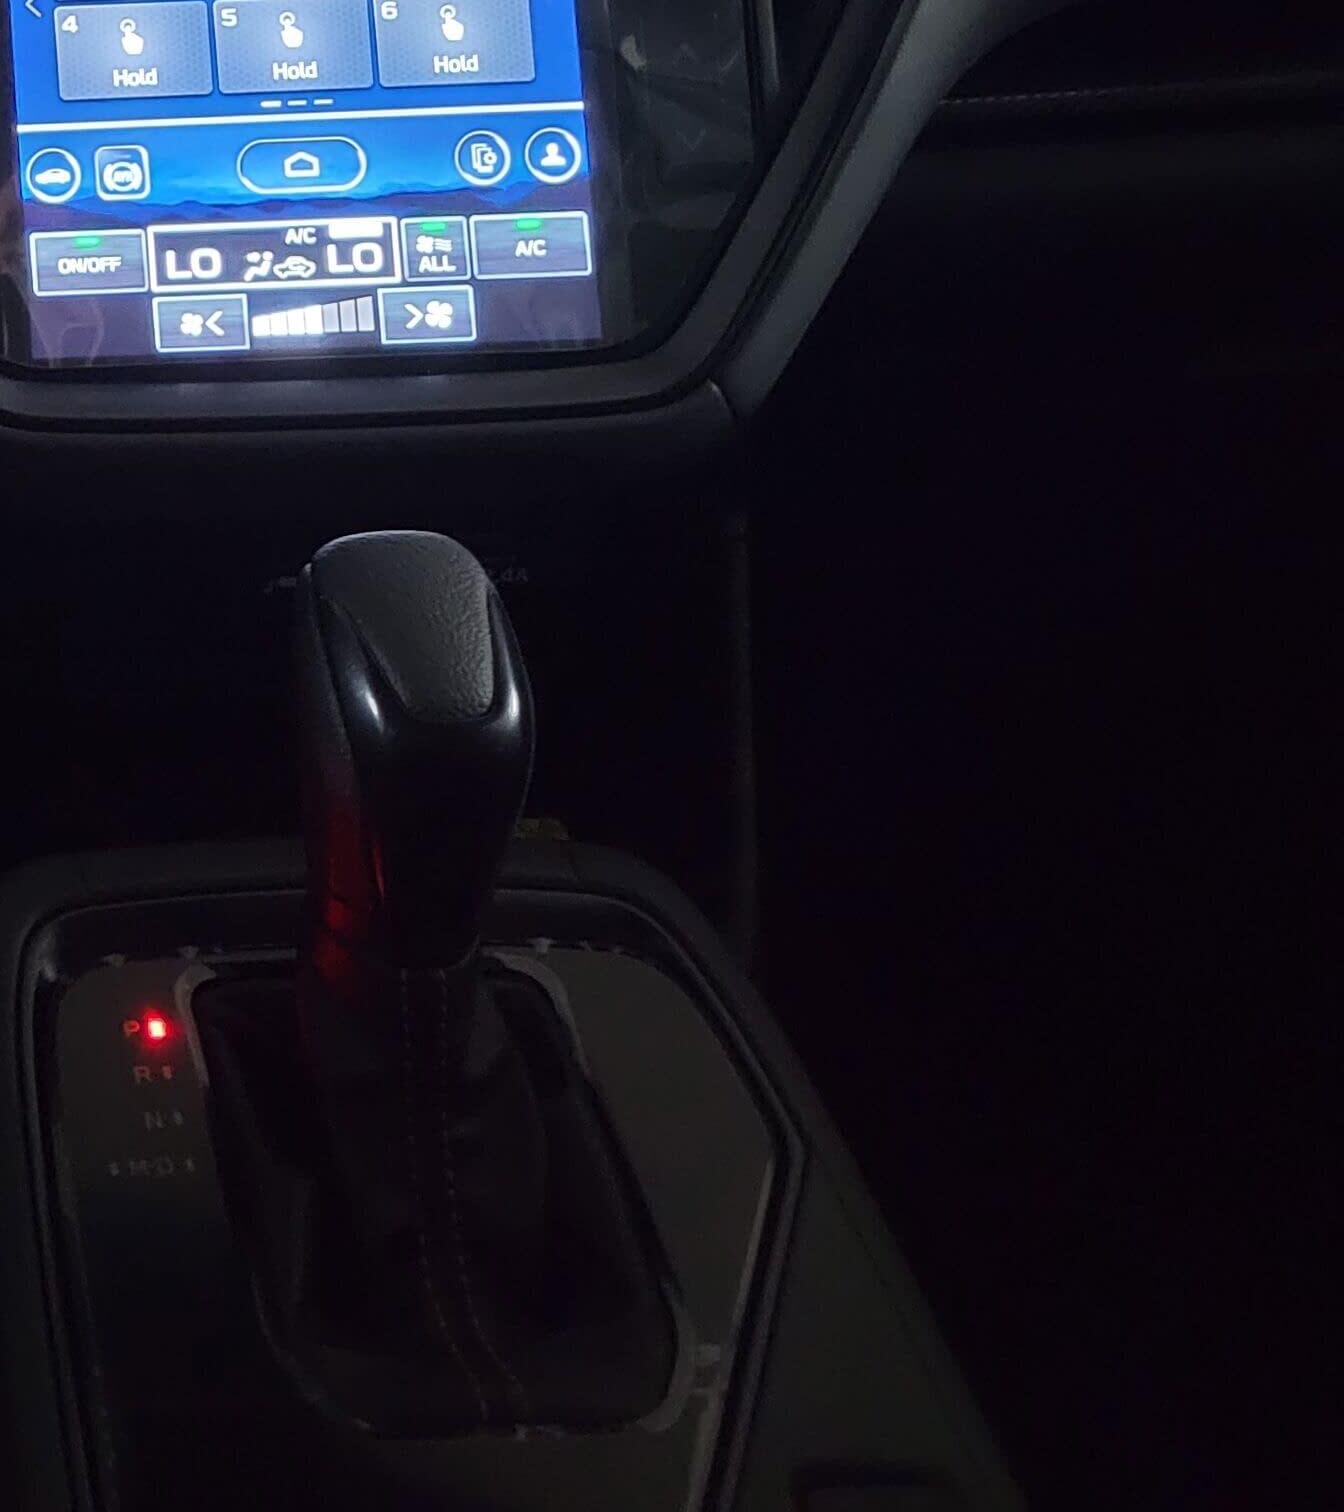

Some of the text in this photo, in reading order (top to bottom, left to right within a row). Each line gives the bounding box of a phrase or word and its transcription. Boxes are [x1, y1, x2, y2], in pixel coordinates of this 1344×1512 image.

[221, 8, 238, 26] 5
[381, 2, 398, 20] 6
[61, 15, 78, 33] 4
[272, 61, 318, 80] Hold
[433, 55, 479, 74] Hold
[112, 68, 159, 87] Hold
[285, 228, 317, 245] A/C
[515, 240, 547, 257] A/C
[57, 256, 122, 274] ON/OFF
[165, 248, 222, 280] LO
[327, 242, 383, 274] LO
[419, 256, 456, 273] ALL
[124, 1021, 139, 1037] P
